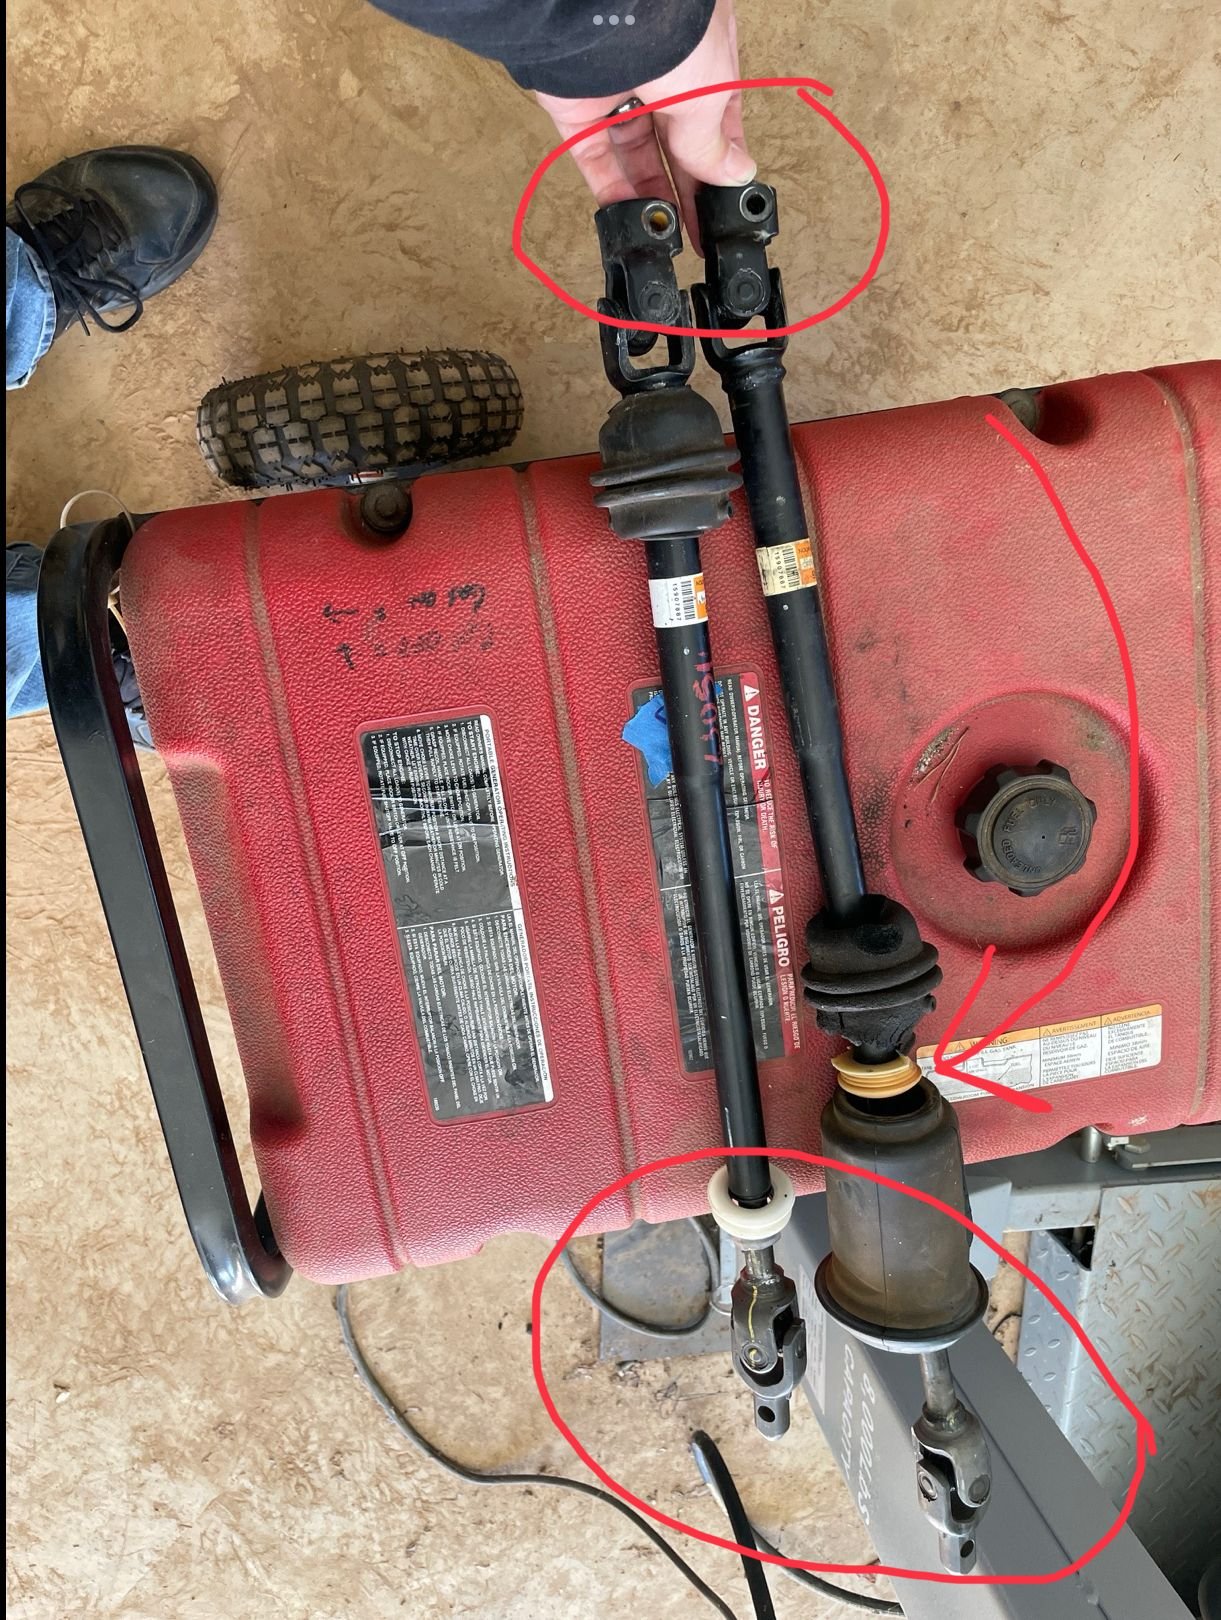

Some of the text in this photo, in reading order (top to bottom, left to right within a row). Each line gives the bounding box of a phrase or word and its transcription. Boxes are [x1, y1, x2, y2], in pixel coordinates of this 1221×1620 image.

[391, 731, 398, 741] TO
[466, 720, 472, 730] TO
[746, 704, 766, 770] DANGER
[386, 737, 395, 767] DISCONNECT
[393, 741, 401, 758] STOP
[429, 731, 437, 747] GRASP
[460, 726, 469, 756] DISCONNECT
[468, 730, 476, 751] START
[429, 758, 437, 777] RAPIDLY
[432, 747, 440, 765] RECOIL
[457, 757, 465, 776] ROTATE
[416, 760, 424, 781] SEVERAL
[420, 782, 428, 803] SECONDS
[446, 743, 454, 759] CHOKE
[453, 782, 461, 800] CHOKE
[482, 773, 491, 803] COMPLETELY
[483, 728, 515, 887] PORTABLE GENERATOR OPERATING INSTRUCTIONS
[1003, 807, 1025, 833] FUEL
[412, 769, 420, 787] ENGINE
[431, 872, 439, 894] OPERATE
[760, 811, 769, 832] DEATH.
[768, 823, 776, 838] RISK
[431, 811, 439, 832] POSITION
[438, 851, 446, 873] DISTANCE
[447, 828, 456, 855] RESISTANCE
[499, 914, 507, 931] PARA
[428, 925, 436, 942] PARA
[432, 943, 440, 963] PARAR
[502, 931, 512, 962] ENCENDER
[771, 905, 790, 967] PELIGRO
[513, 954, 521, 978] OPERADOR
[516, 923, 527, 961] GENERADOR
[528, 991, 540, 1037] INSTRUCCIONES
[786, 973, 794, 989] PARA
[791, 1020, 799, 1040] RIESGO
[1113, 1010, 1149, 1022] ADVERTENCIA
[1051, 1020, 1096, 1033] AVERTISSEMENT
[969, 1035, 1007, 1049] WNING
[841, 1344, 855, 1481] CAPACITY
